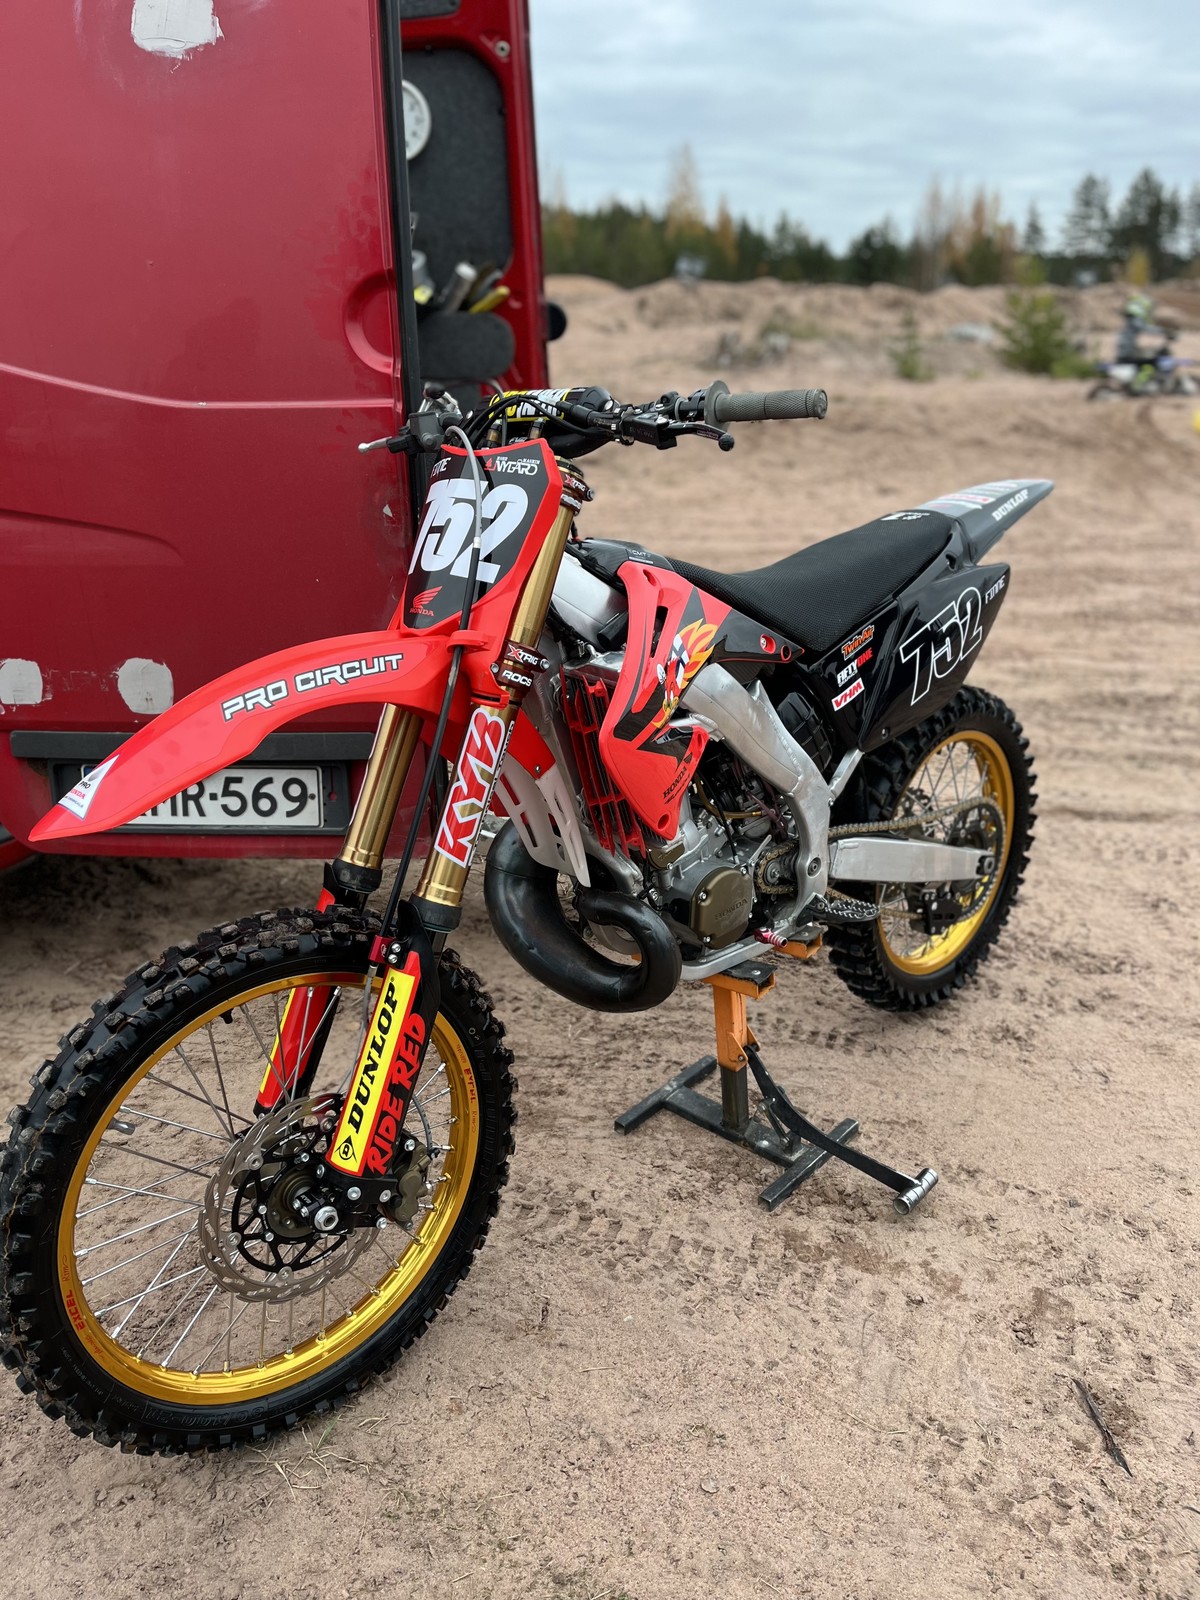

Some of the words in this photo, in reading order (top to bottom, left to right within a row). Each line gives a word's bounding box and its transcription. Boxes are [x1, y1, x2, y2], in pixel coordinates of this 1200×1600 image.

[992, 489, 1029, 521] DUNLOP
[409, 608, 435, 616] HONDA
[507, 643, 539, 664] XTRIG
[899, 586, 983, 706] 752
[221, 680, 289, 722] PRO
[294, 653, 404, 692] CIRCUIT
[501, 669, 533, 687] ROCS
[834, 681, 862, 708] VHM
[139, 776, 309, 818] R-569
[434, 707, 505, 868] KYB
[663, 766, 687, 799] HONDA
[714, 898, 749, 921] HONDA
[348, 981, 397, 1135] DUNLOP
[367, 1091, 405, 1176] RIDE
[392, 1013, 426, 1090] RED
[66, 1289, 86, 1331] EXCEL
